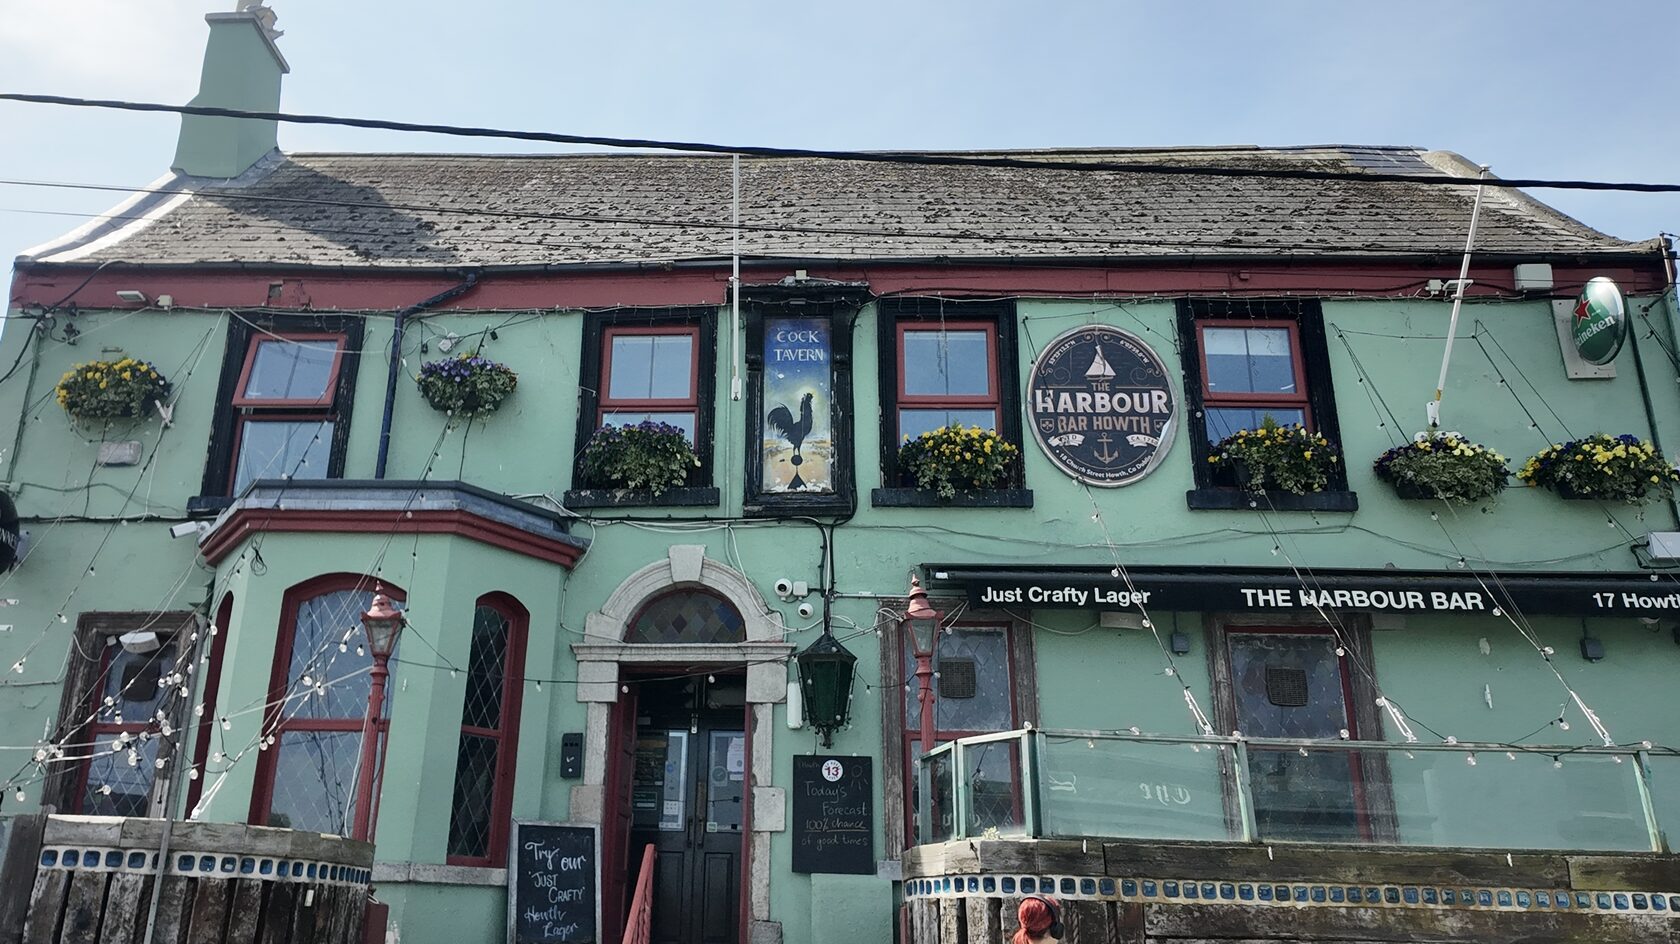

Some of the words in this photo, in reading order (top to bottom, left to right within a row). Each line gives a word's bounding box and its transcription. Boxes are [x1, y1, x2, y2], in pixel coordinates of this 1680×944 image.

[776, 330, 820, 343] COCK
[1576, 315, 1616, 346] ineken
[774, 348, 824, 362] TAVERN
[1091, 382, 1111, 392] THE
[1035, 389, 1170, 414] HARBOUR
[1057, 415, 1088, 432] BAR
[1092, 415, 1151, 434] HOWTH
[1086, 469, 1104, 478] Street
[1127, 466, 1137, 474] Co
[981, 586, 1023, 603] Just
[1028, 586, 1088, 606] Crafty
[1094, 587, 1151, 607] Lager
[1241, 588, 1293, 607] THE
[1299, 589, 1426, 610] HARBOUR
[1430, 591, 1485, 610] BAR
[1592, 592, 1615, 608] 17
[824, 766, 841, 778] 13
[804, 780, 848, 804] Today's
[805, 818, 829, 832] 100%
[816, 833, 839, 852] good
[525, 841, 560, 870] Try
[560, 855, 587, 871] our
[543, 921, 579, 942] Lager
